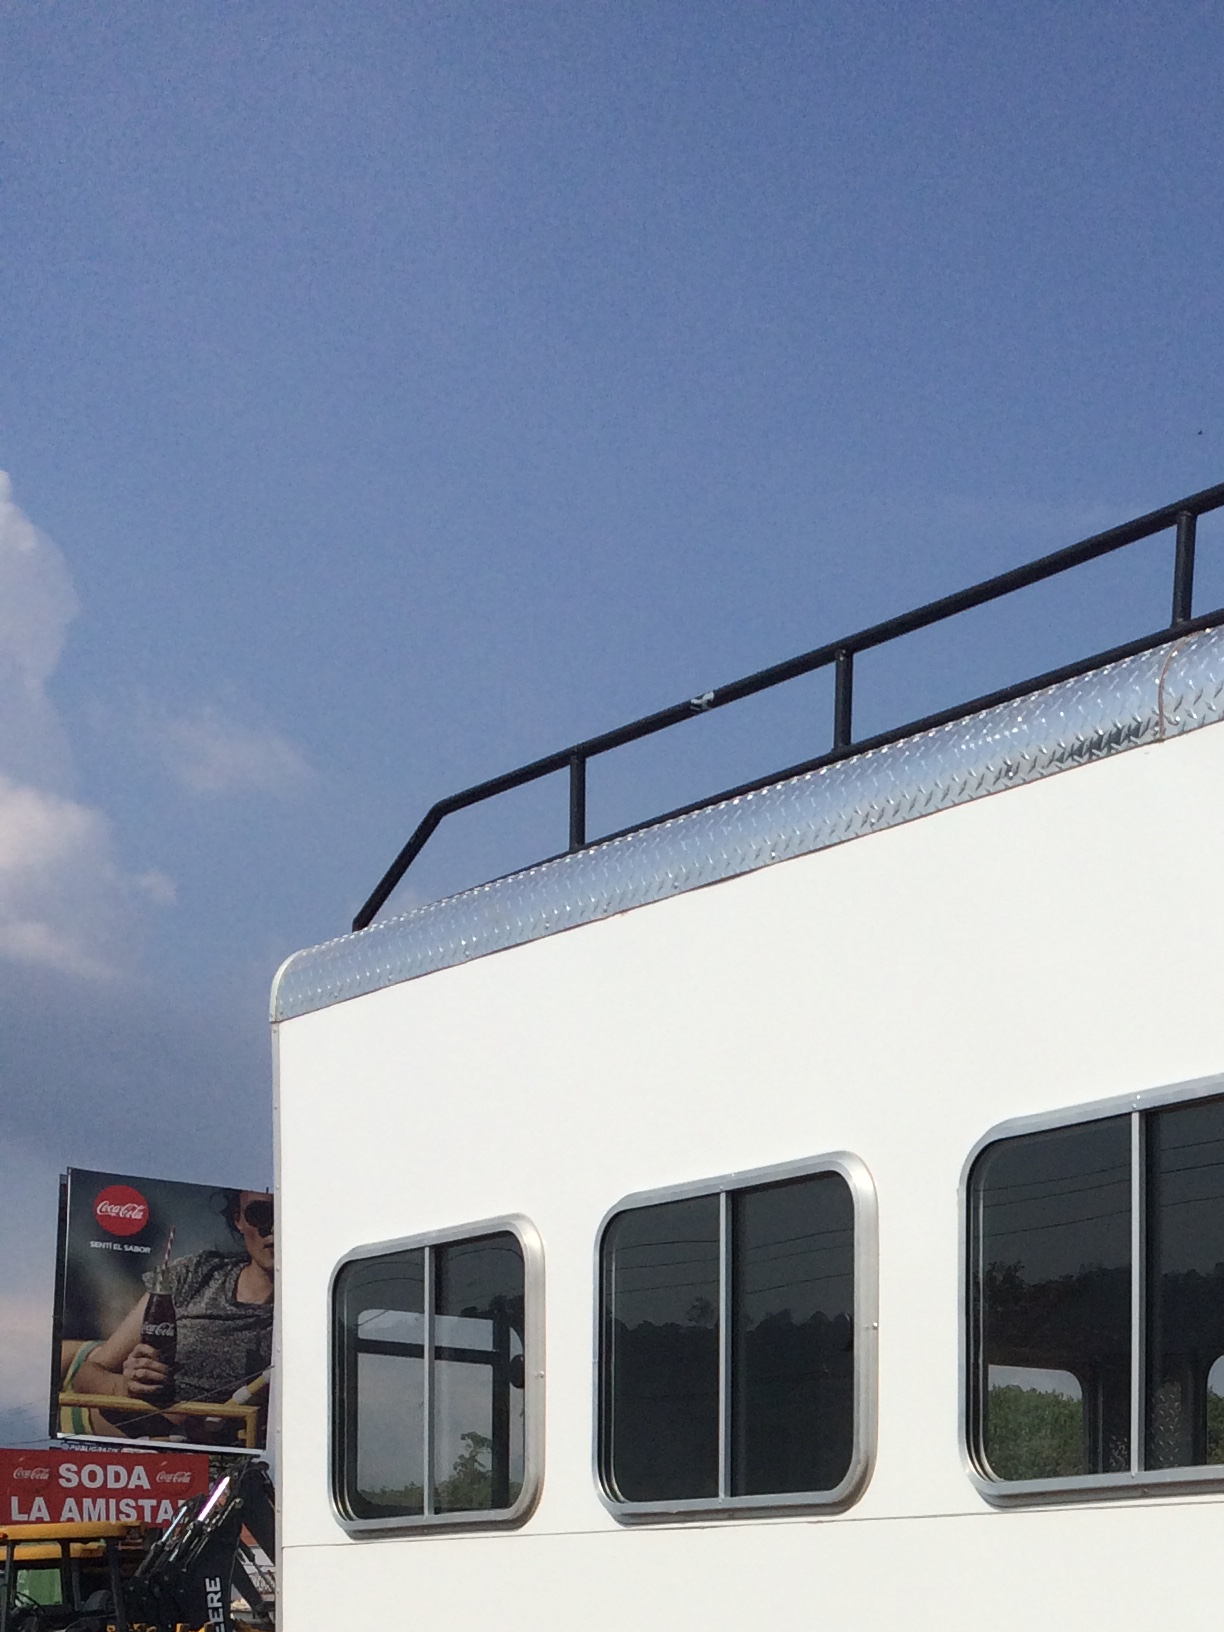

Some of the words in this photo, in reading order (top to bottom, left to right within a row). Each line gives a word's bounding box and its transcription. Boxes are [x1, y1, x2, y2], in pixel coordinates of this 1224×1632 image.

[112, 1243, 123, 1251] EL
[123, 1244, 151, 1254] SABOR
[58, 1463, 151, 1490] SODA
[10, 1496, 50, 1522] LA
